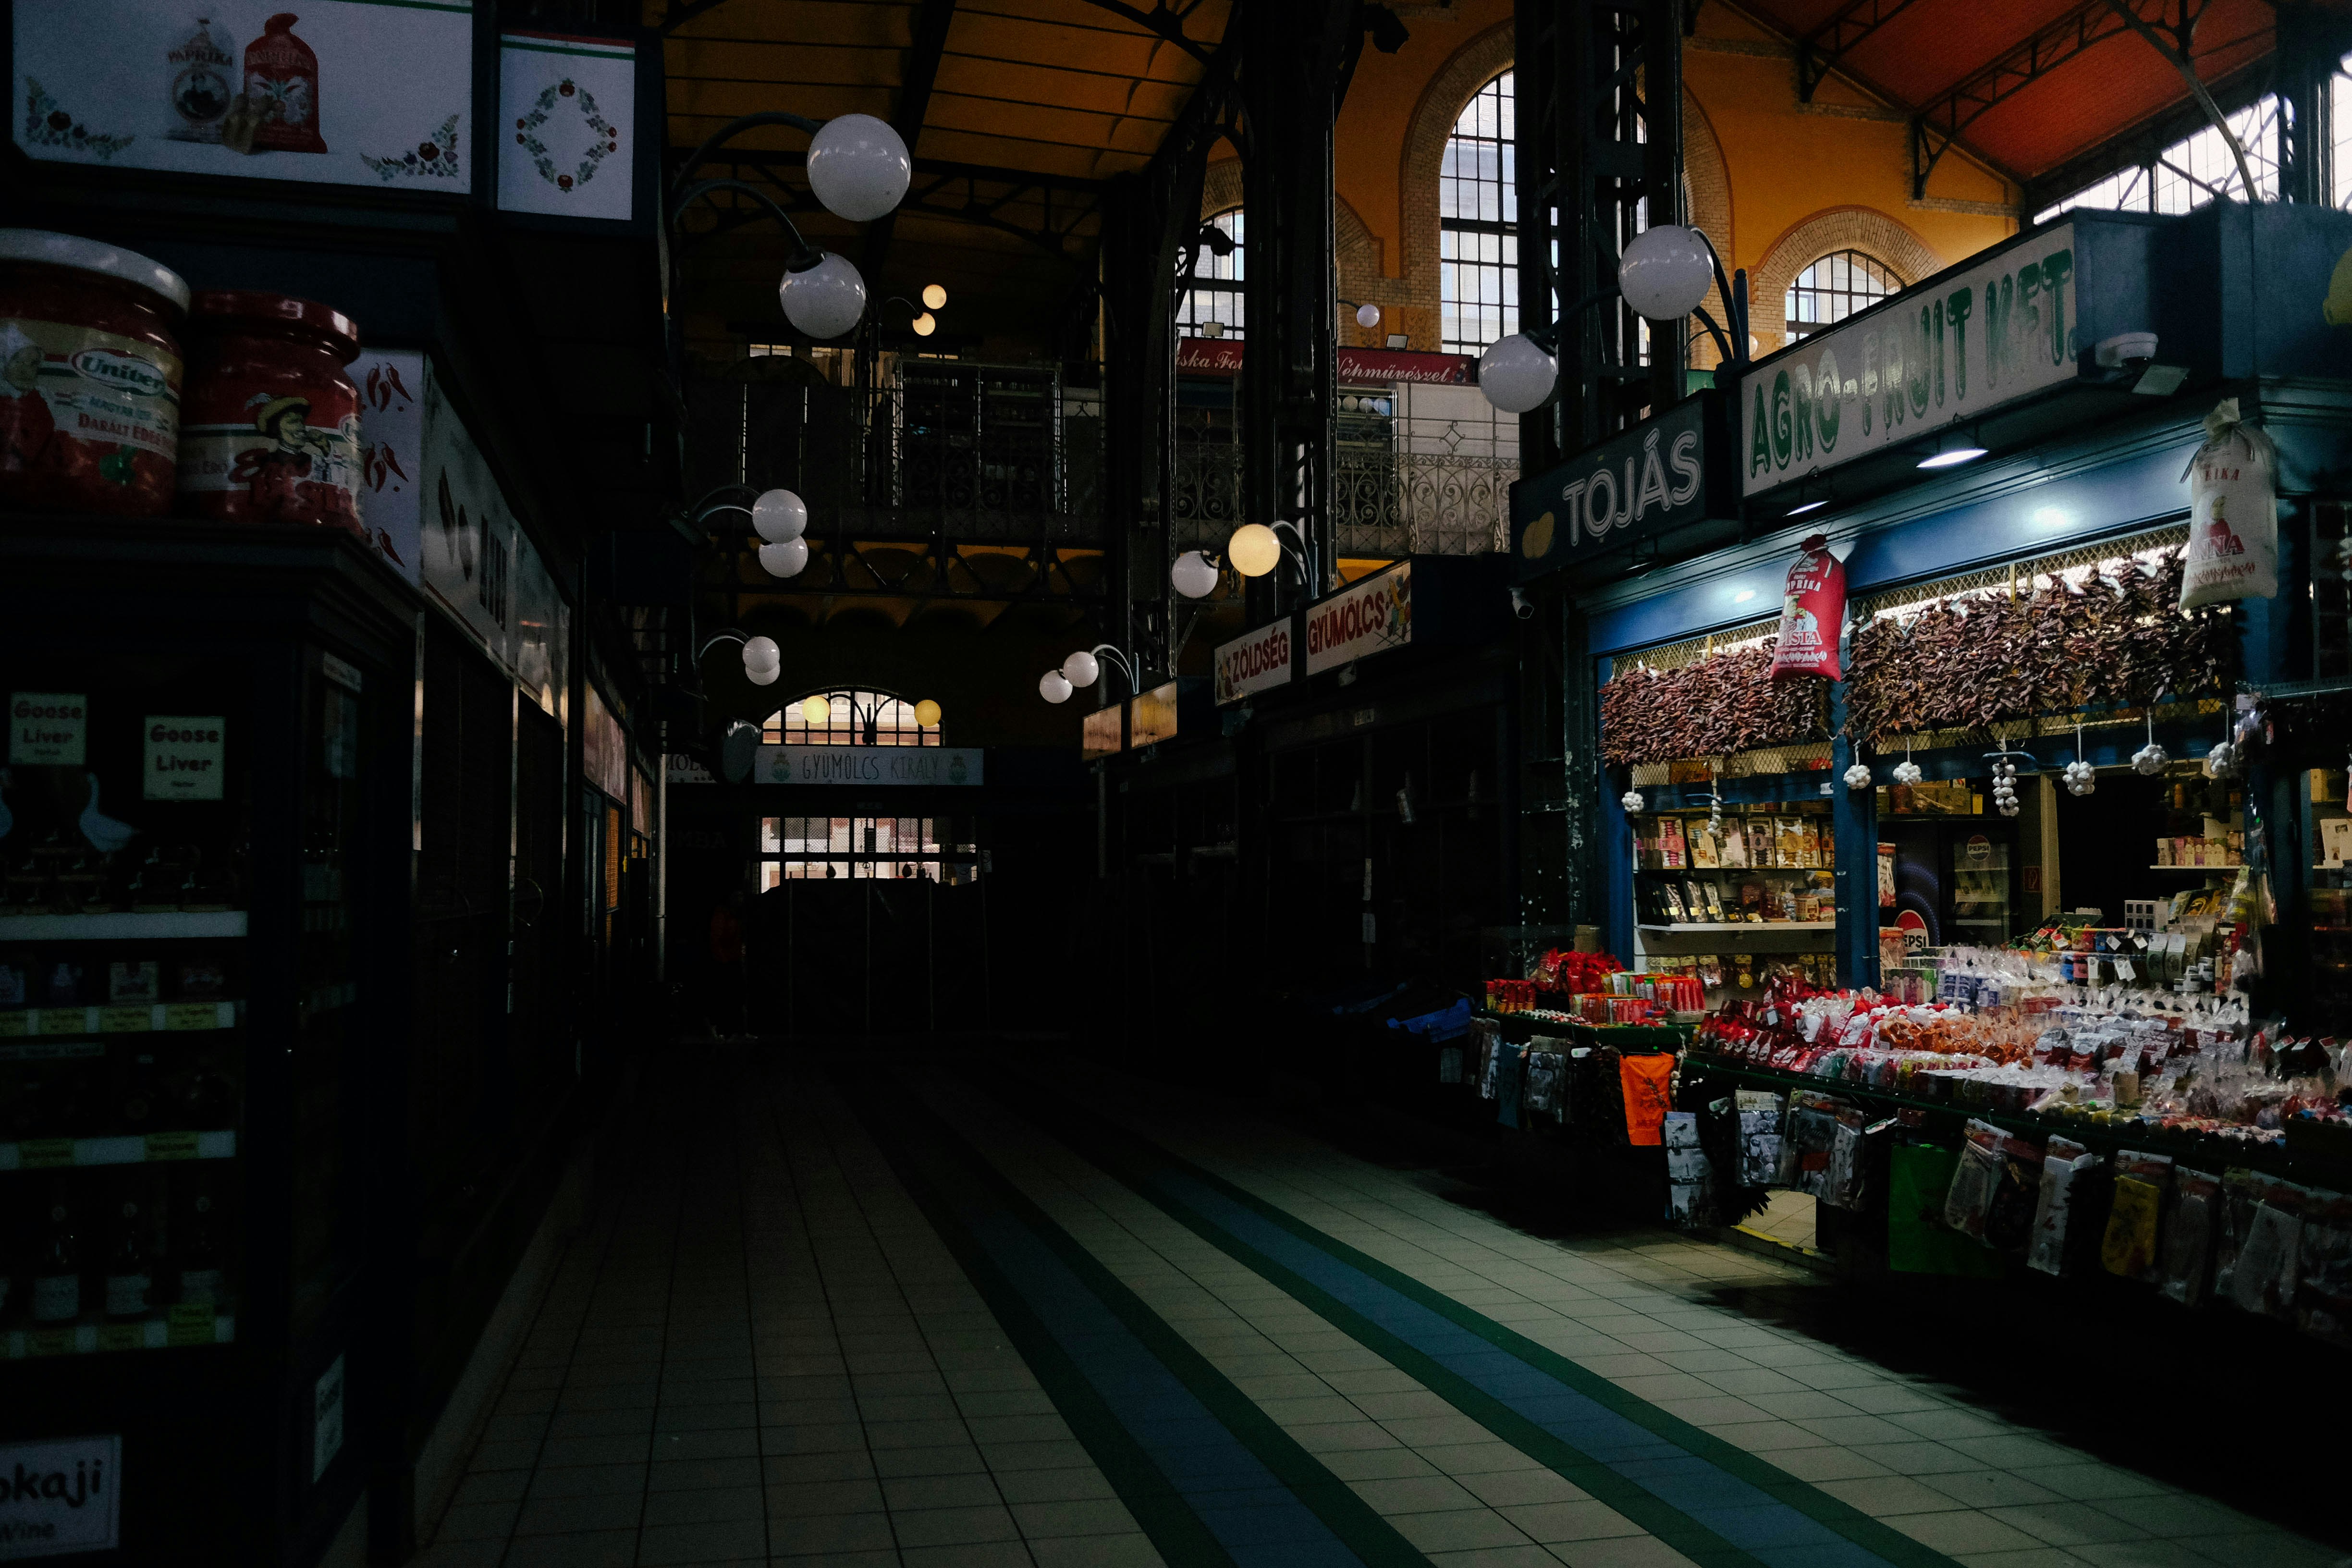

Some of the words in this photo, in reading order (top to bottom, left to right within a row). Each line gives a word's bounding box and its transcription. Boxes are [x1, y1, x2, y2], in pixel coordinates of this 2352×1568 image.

[1562, 427, 1702, 547] TOJÁS
[1308, 590, 1384, 655] GYÜMÖLCS
[1233, 626, 1288, 683] ZÖLDSÉG
[14, 700, 83, 719] Goose
[23, 728, 74, 744] Liver
[150, 724, 219, 743] Goose
[156, 755, 212, 771] Liver
[1903, 934, 1926, 948] EPSI
